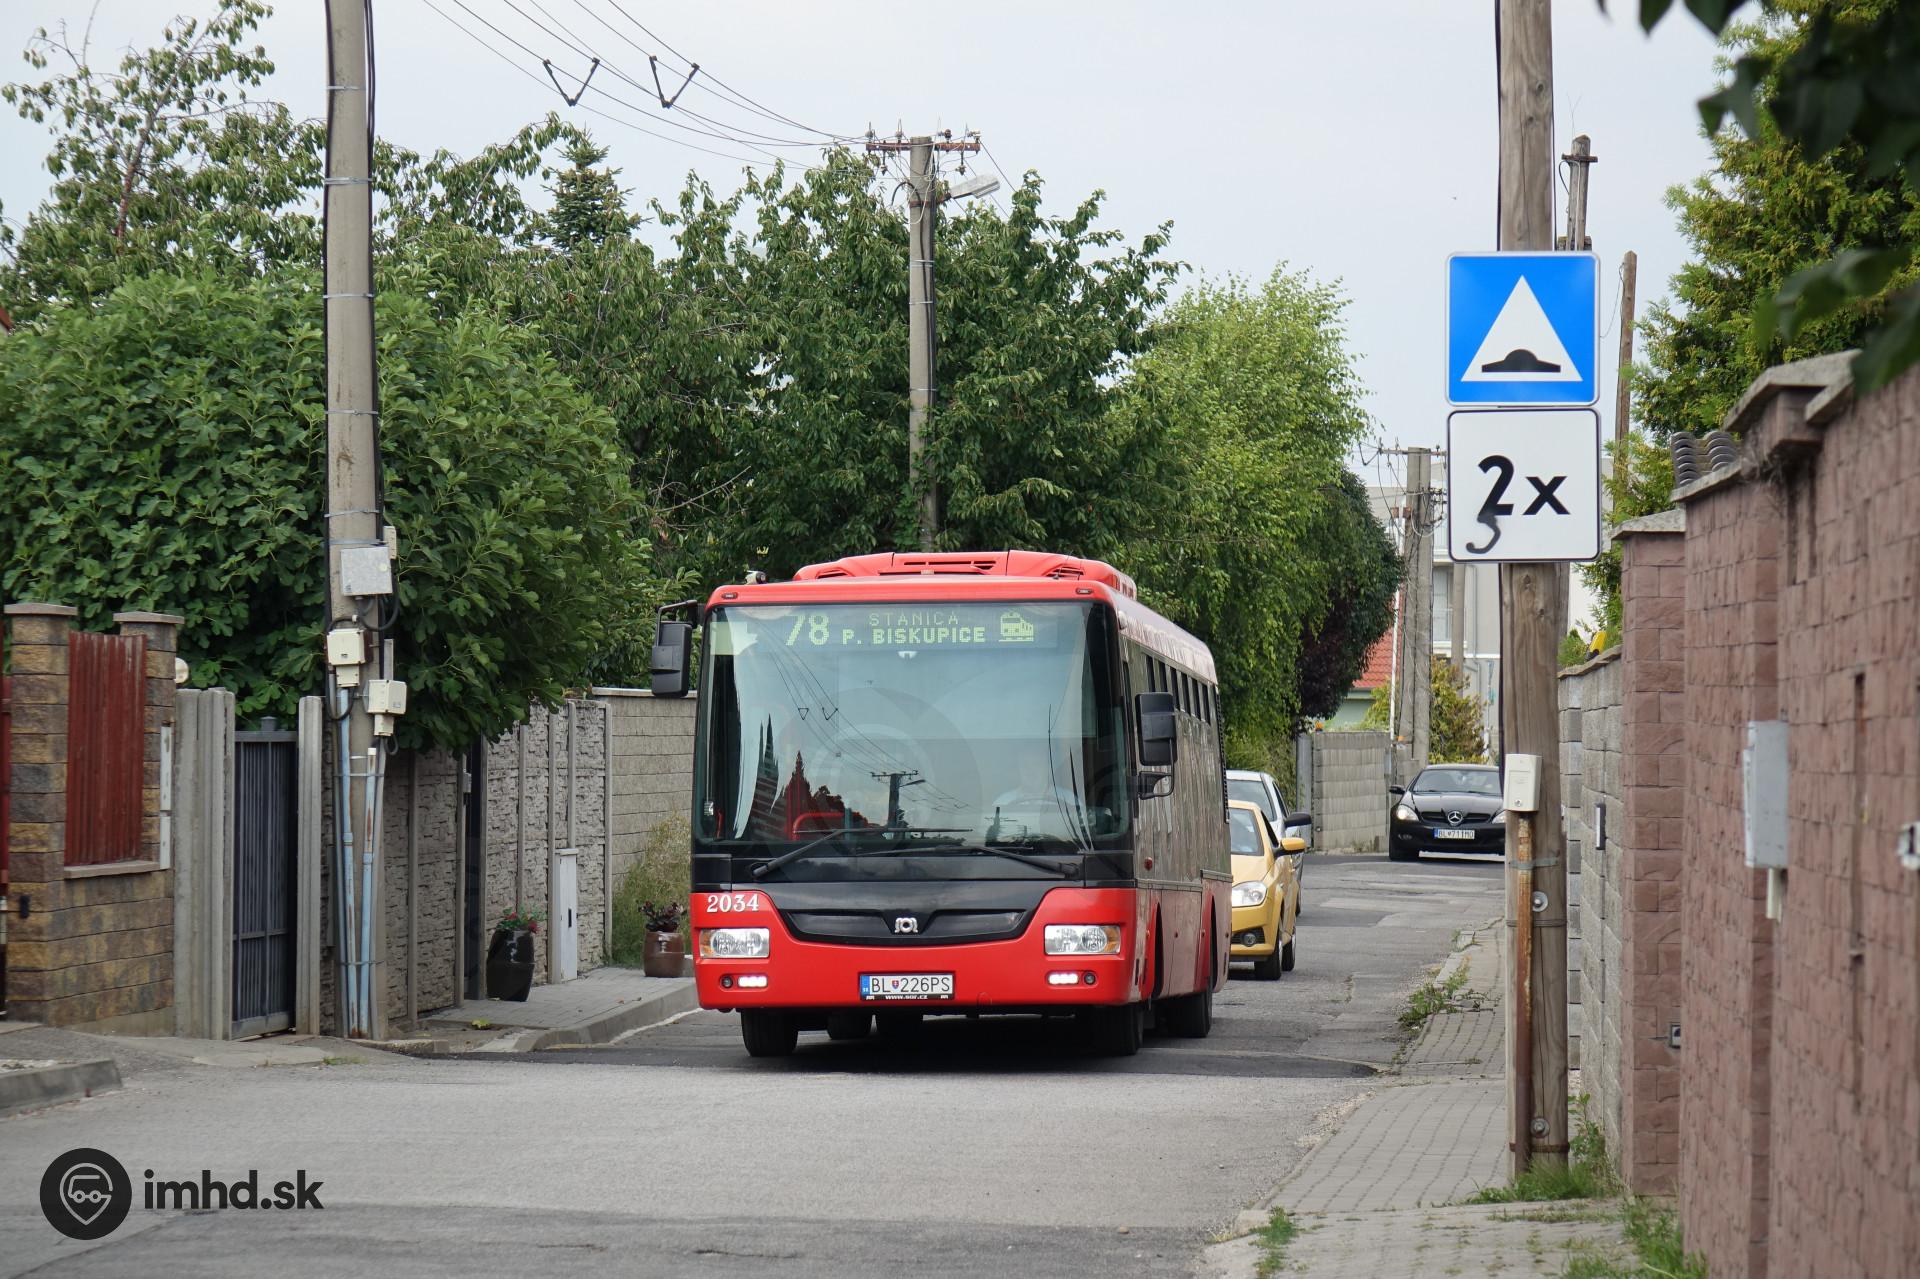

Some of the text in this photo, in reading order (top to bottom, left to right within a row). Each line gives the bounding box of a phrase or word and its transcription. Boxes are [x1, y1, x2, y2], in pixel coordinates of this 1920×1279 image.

[1477, 454, 1571, 516] 2x
[869, 611, 959, 627] STANICA
[784, 612, 830, 646] 78
[842, 627, 986, 645] P. BISKUPICE
[706, 894, 760, 913] 2034
